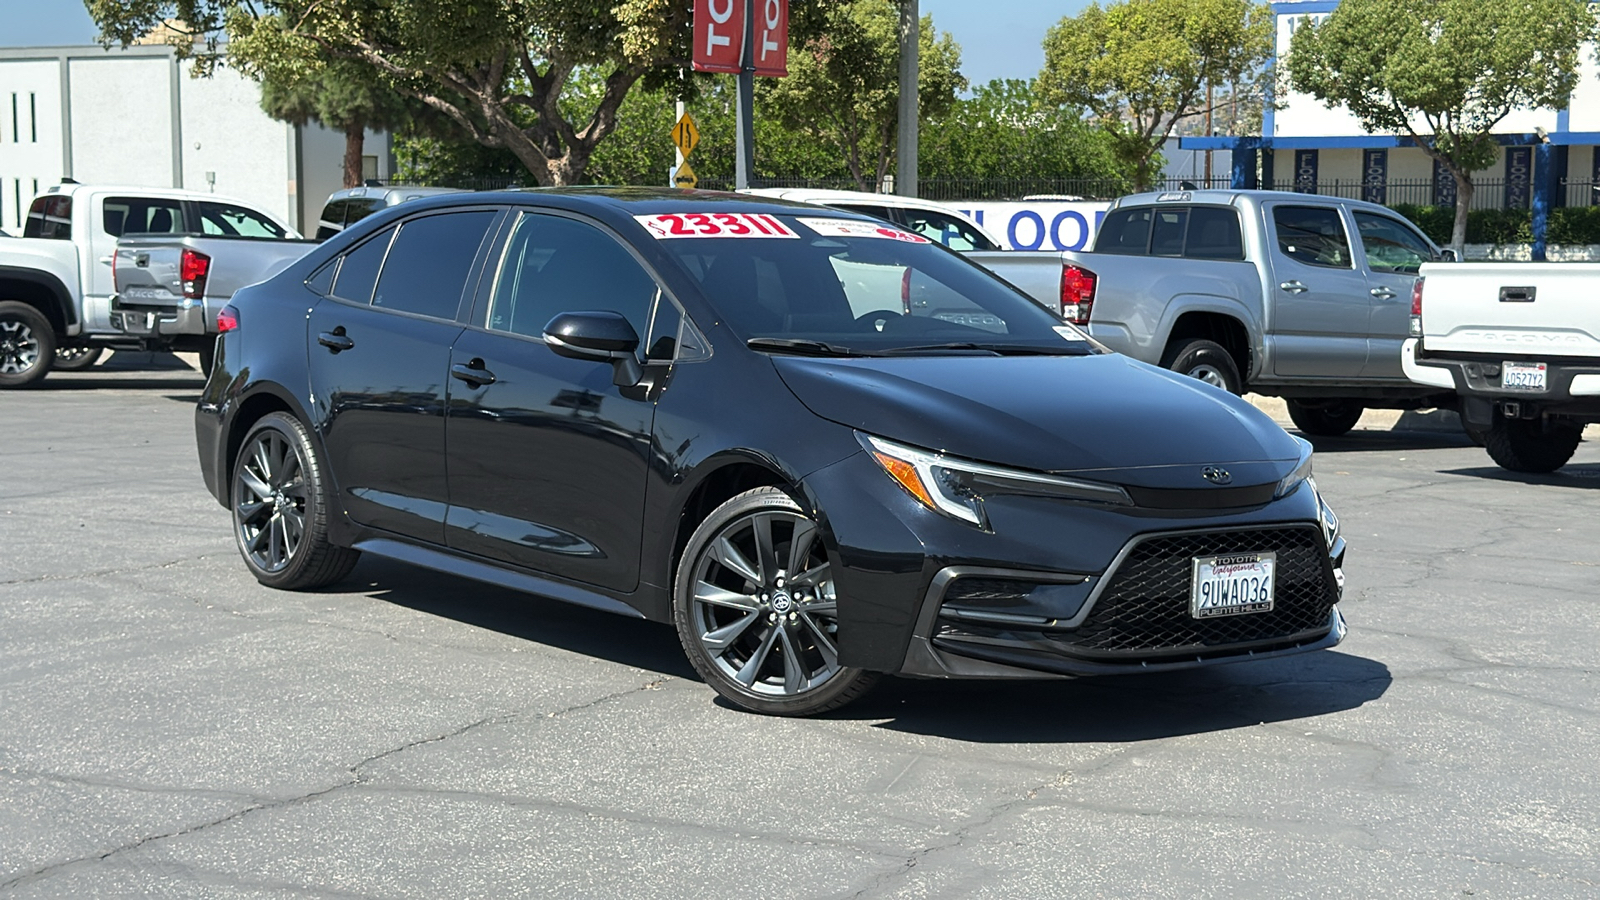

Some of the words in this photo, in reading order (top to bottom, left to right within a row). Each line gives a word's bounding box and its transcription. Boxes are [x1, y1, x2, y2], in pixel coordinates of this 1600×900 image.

[1217, 555, 1258, 565] TOYOTA
[1212, 563, 1259, 577] California
[1201, 576, 1269, 608] 9UWA036
[1200, 605, 1240, 617] PUENTE
[1241, 602, 1270, 613] HILLS
